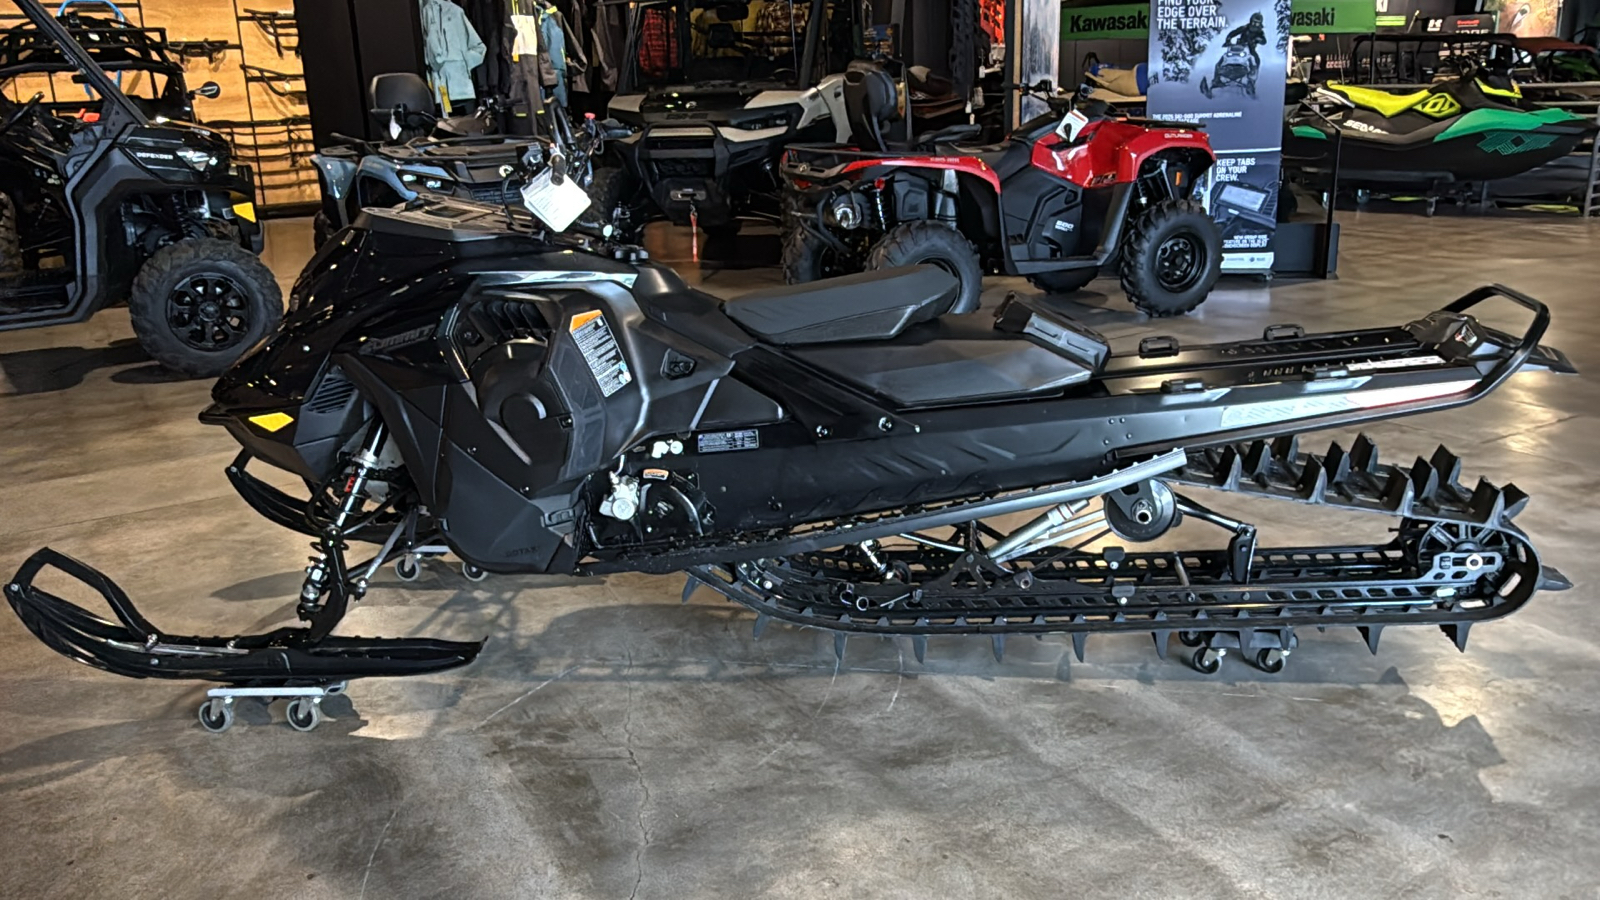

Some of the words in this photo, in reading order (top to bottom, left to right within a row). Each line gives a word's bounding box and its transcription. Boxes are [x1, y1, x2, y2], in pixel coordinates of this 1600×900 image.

[1157, 6, 1186, 18] EDGE
[1187, 4, 1217, 17] OVER
[1070, 10, 1148, 33] Kawasak
[1156, 18, 1178, 30] THE
[1180, 15, 1229, 30] TERRAIN.
[136, 152, 173, 160] DEFENDER
[1216, 158, 1236, 167] KEEP
[1237, 157, 1256, 166] TABS
[1216, 166, 1227, 174] ON
[1228, 165, 1248, 174] YOUR
[1215, 173, 1240, 182] CREW.
